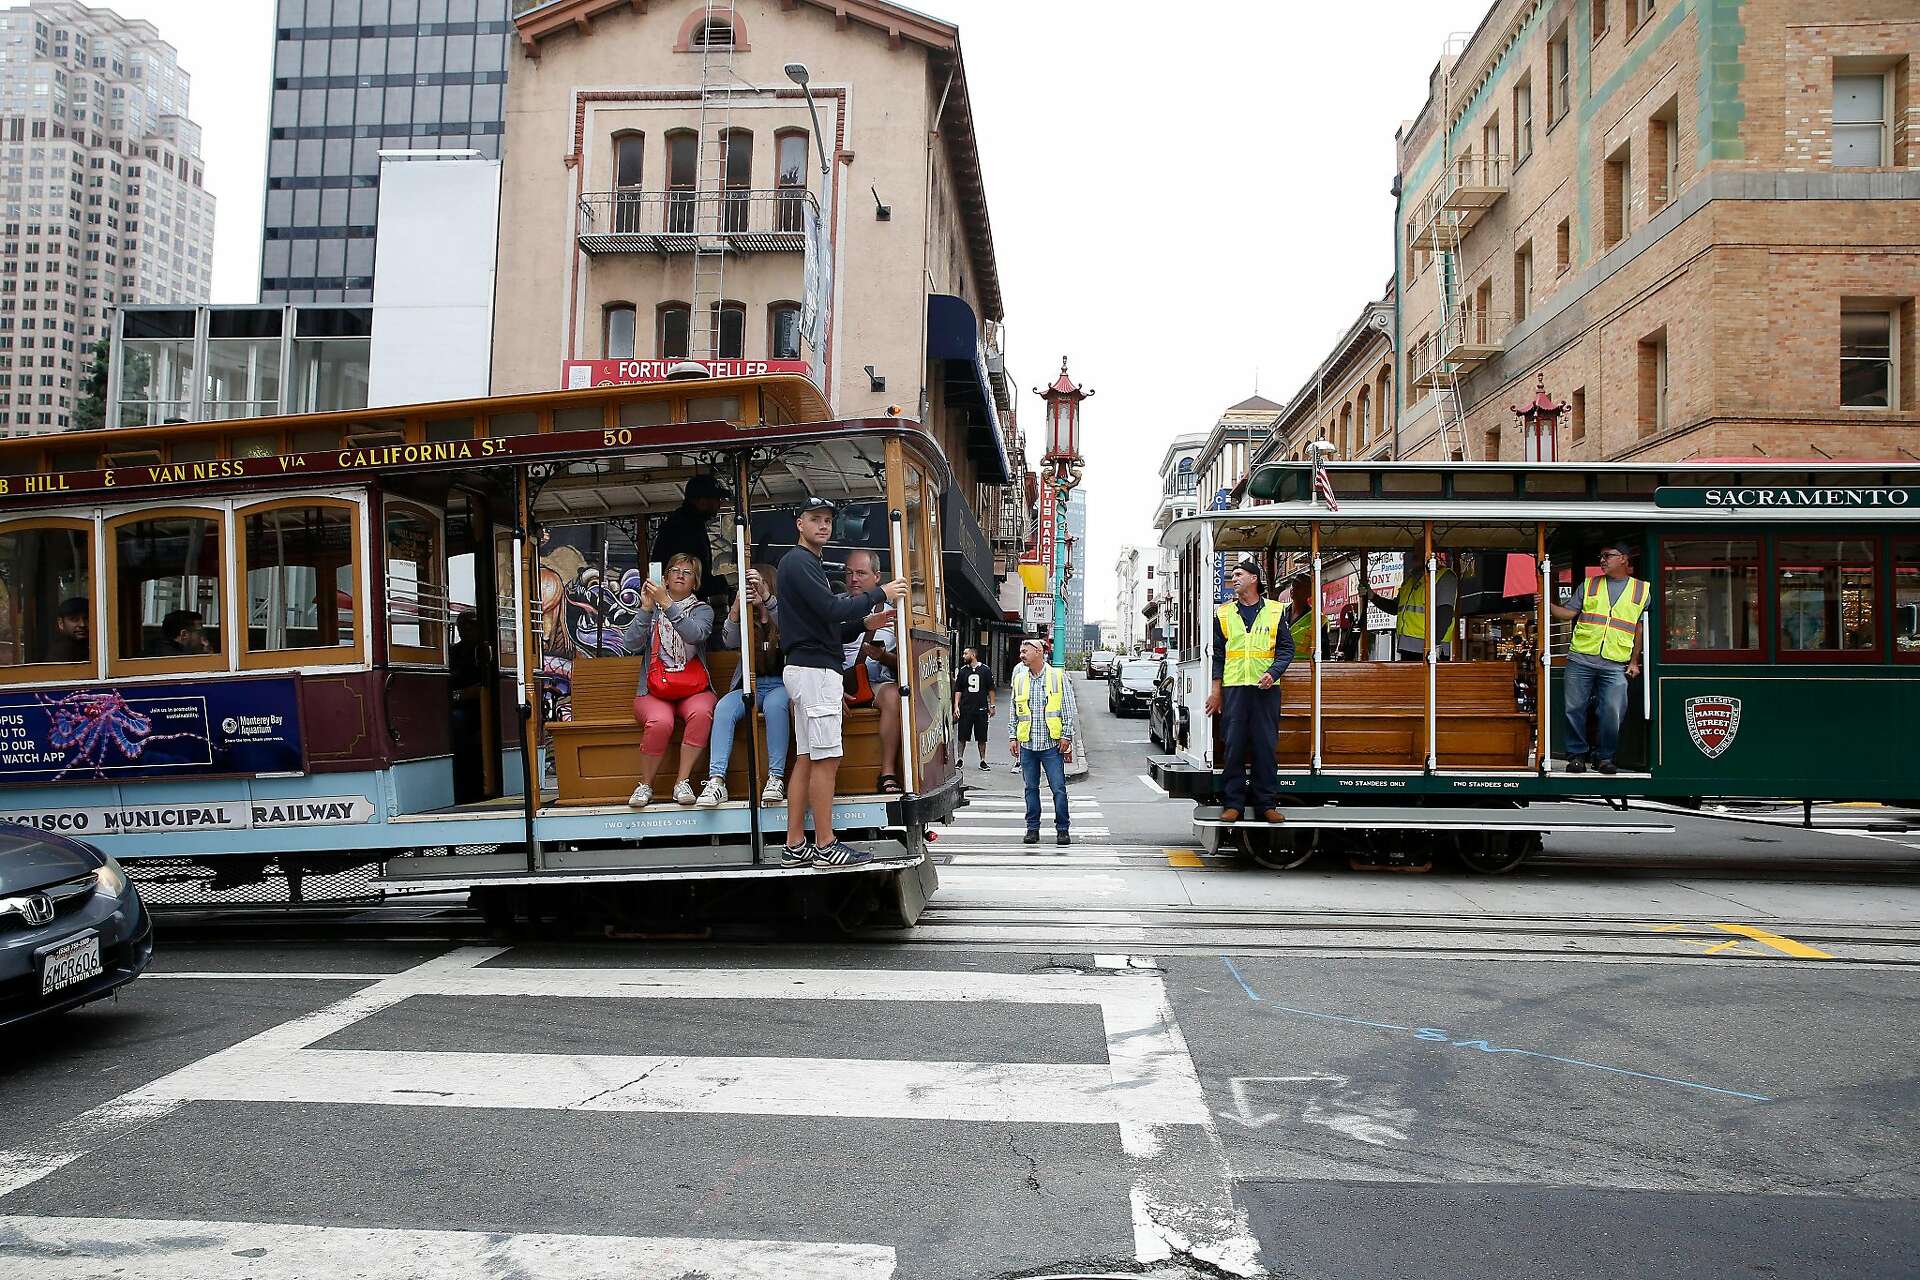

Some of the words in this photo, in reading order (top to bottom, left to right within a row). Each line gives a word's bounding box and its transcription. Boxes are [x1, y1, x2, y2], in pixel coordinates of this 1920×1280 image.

[619, 362, 672, 378] FORTU
[707, 362, 767, 377] TELLER
[603, 429, 632, 446] 50
[25, 474, 69, 492] HILL
[104, 471, 115, 486] &
[148, 465, 186, 483] VAN
[194, 460, 244, 480] NESS
[338, 441, 472, 468] CALIFORNIA
[1705, 488, 1909, 506] SACRAMENTO
[1213, 569, 1222, 600] KONG
[968, 674, 979, 692] 9
[240, 715, 270, 726] Monterey
[270, 714, 283, 726] Bay
[1695, 710, 1731, 718] MARKET
[1697, 719, 1730, 727] STREET
[11, 728, 26, 738] TO
[241, 725, 272, 736] Aquarium
[11, 740, 35, 751] OUR
[2, 753, 40, 764] WATCH
[43, 752, 65, 762] APP
[0, 813, 88, 831] CISCO
[104, 807, 231, 828] MUNICIPAL
[251, 802, 354, 823] RAILWAY
[631, 820, 672, 828] STANDEES
[45, 949, 99, 986] 6MCR606
[55, 978, 69, 990] CITY
